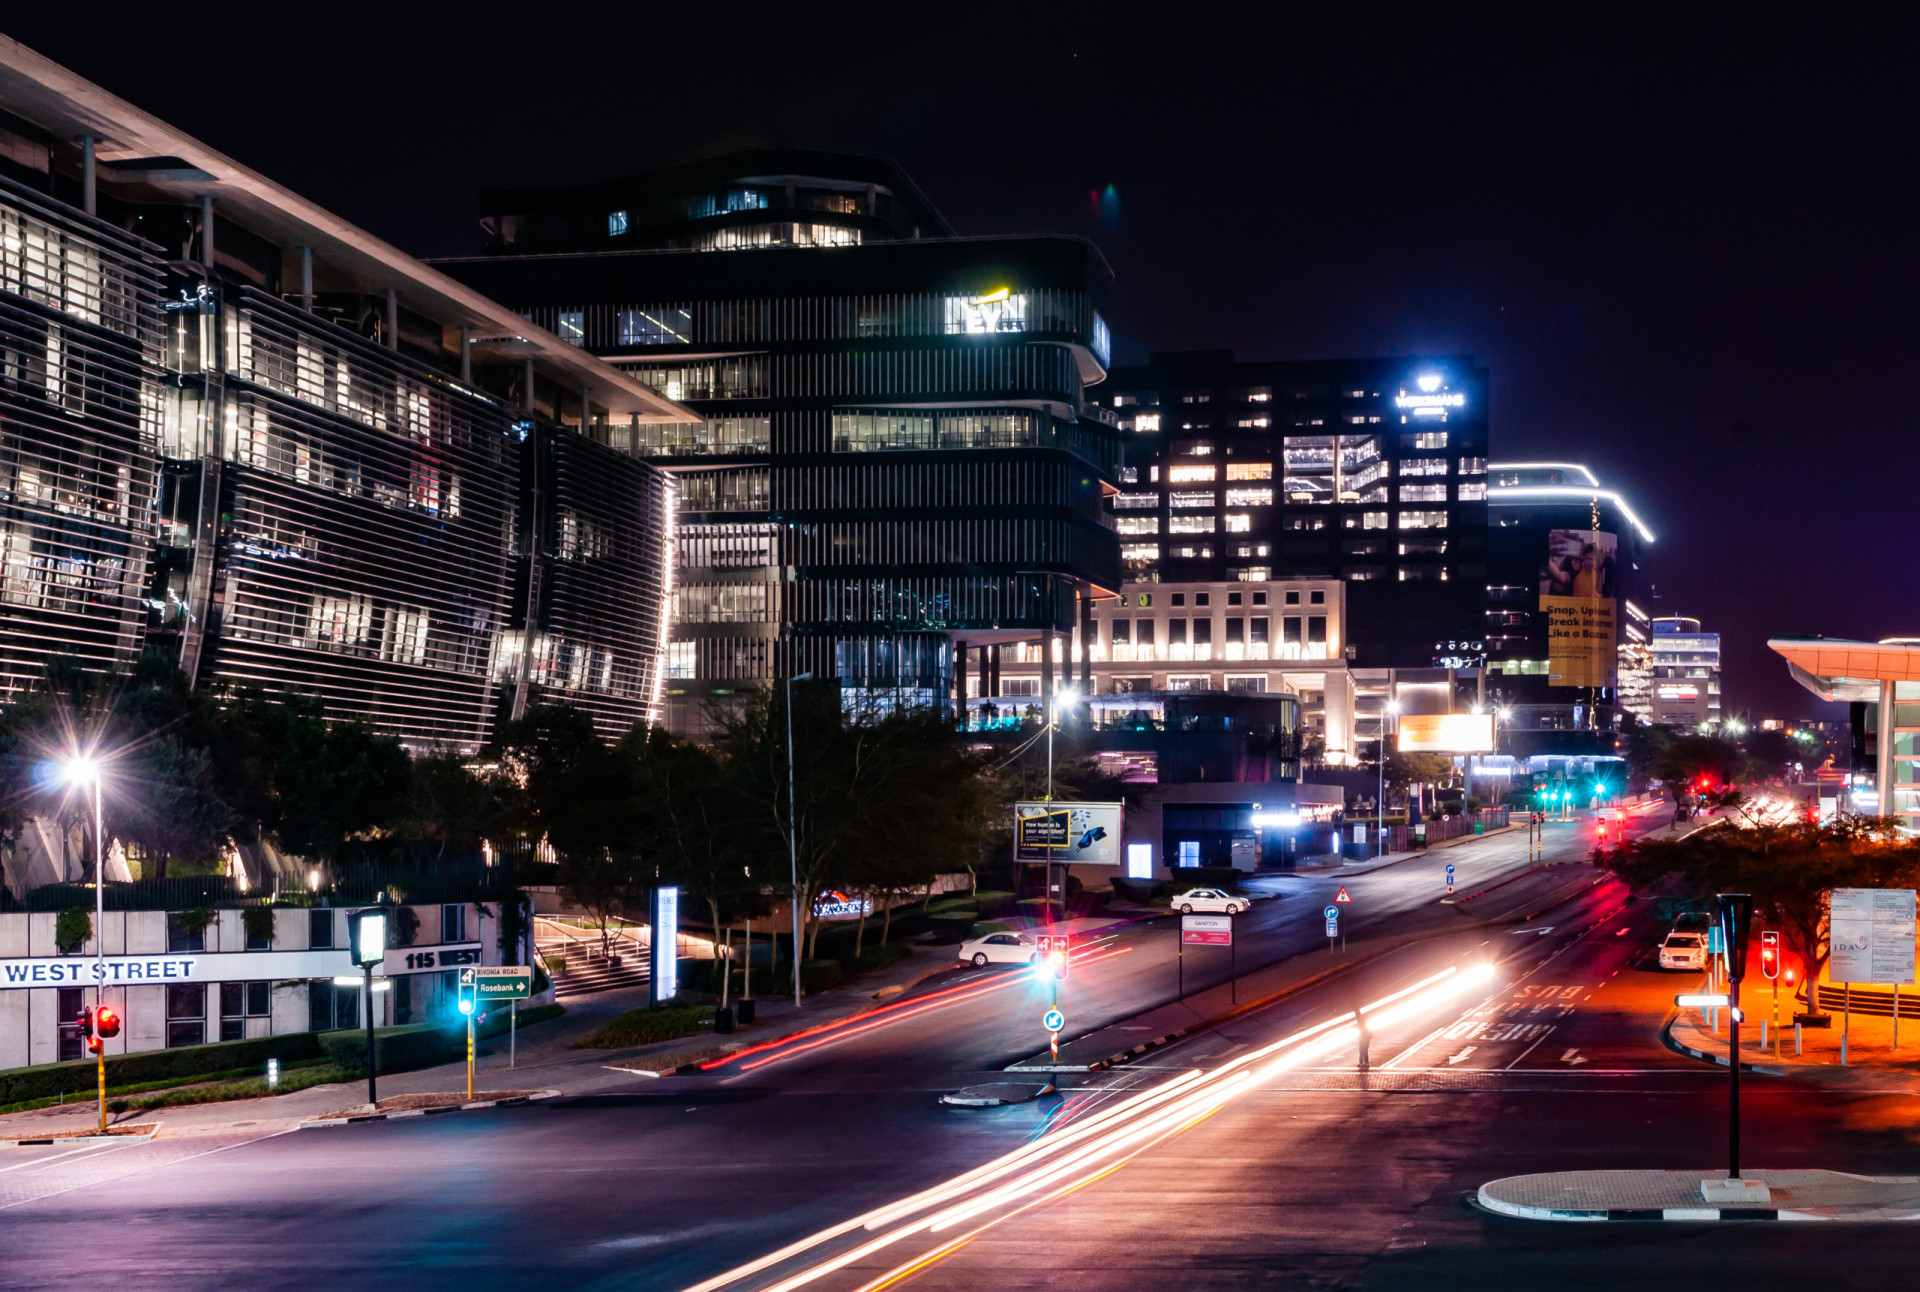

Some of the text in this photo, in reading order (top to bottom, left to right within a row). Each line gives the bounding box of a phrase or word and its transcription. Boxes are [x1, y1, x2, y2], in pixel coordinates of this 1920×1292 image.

[1546, 605, 1578, 616] Snap.
[1547, 617, 1580, 626] Break
[1547, 629, 1570, 638] Like
[405, 948, 481, 970] 115 WEST
[5, 961, 195, 982] WEST STREET
[477, 968, 501, 976] RIVONIA
[480, 983, 514, 993] Rosebank
